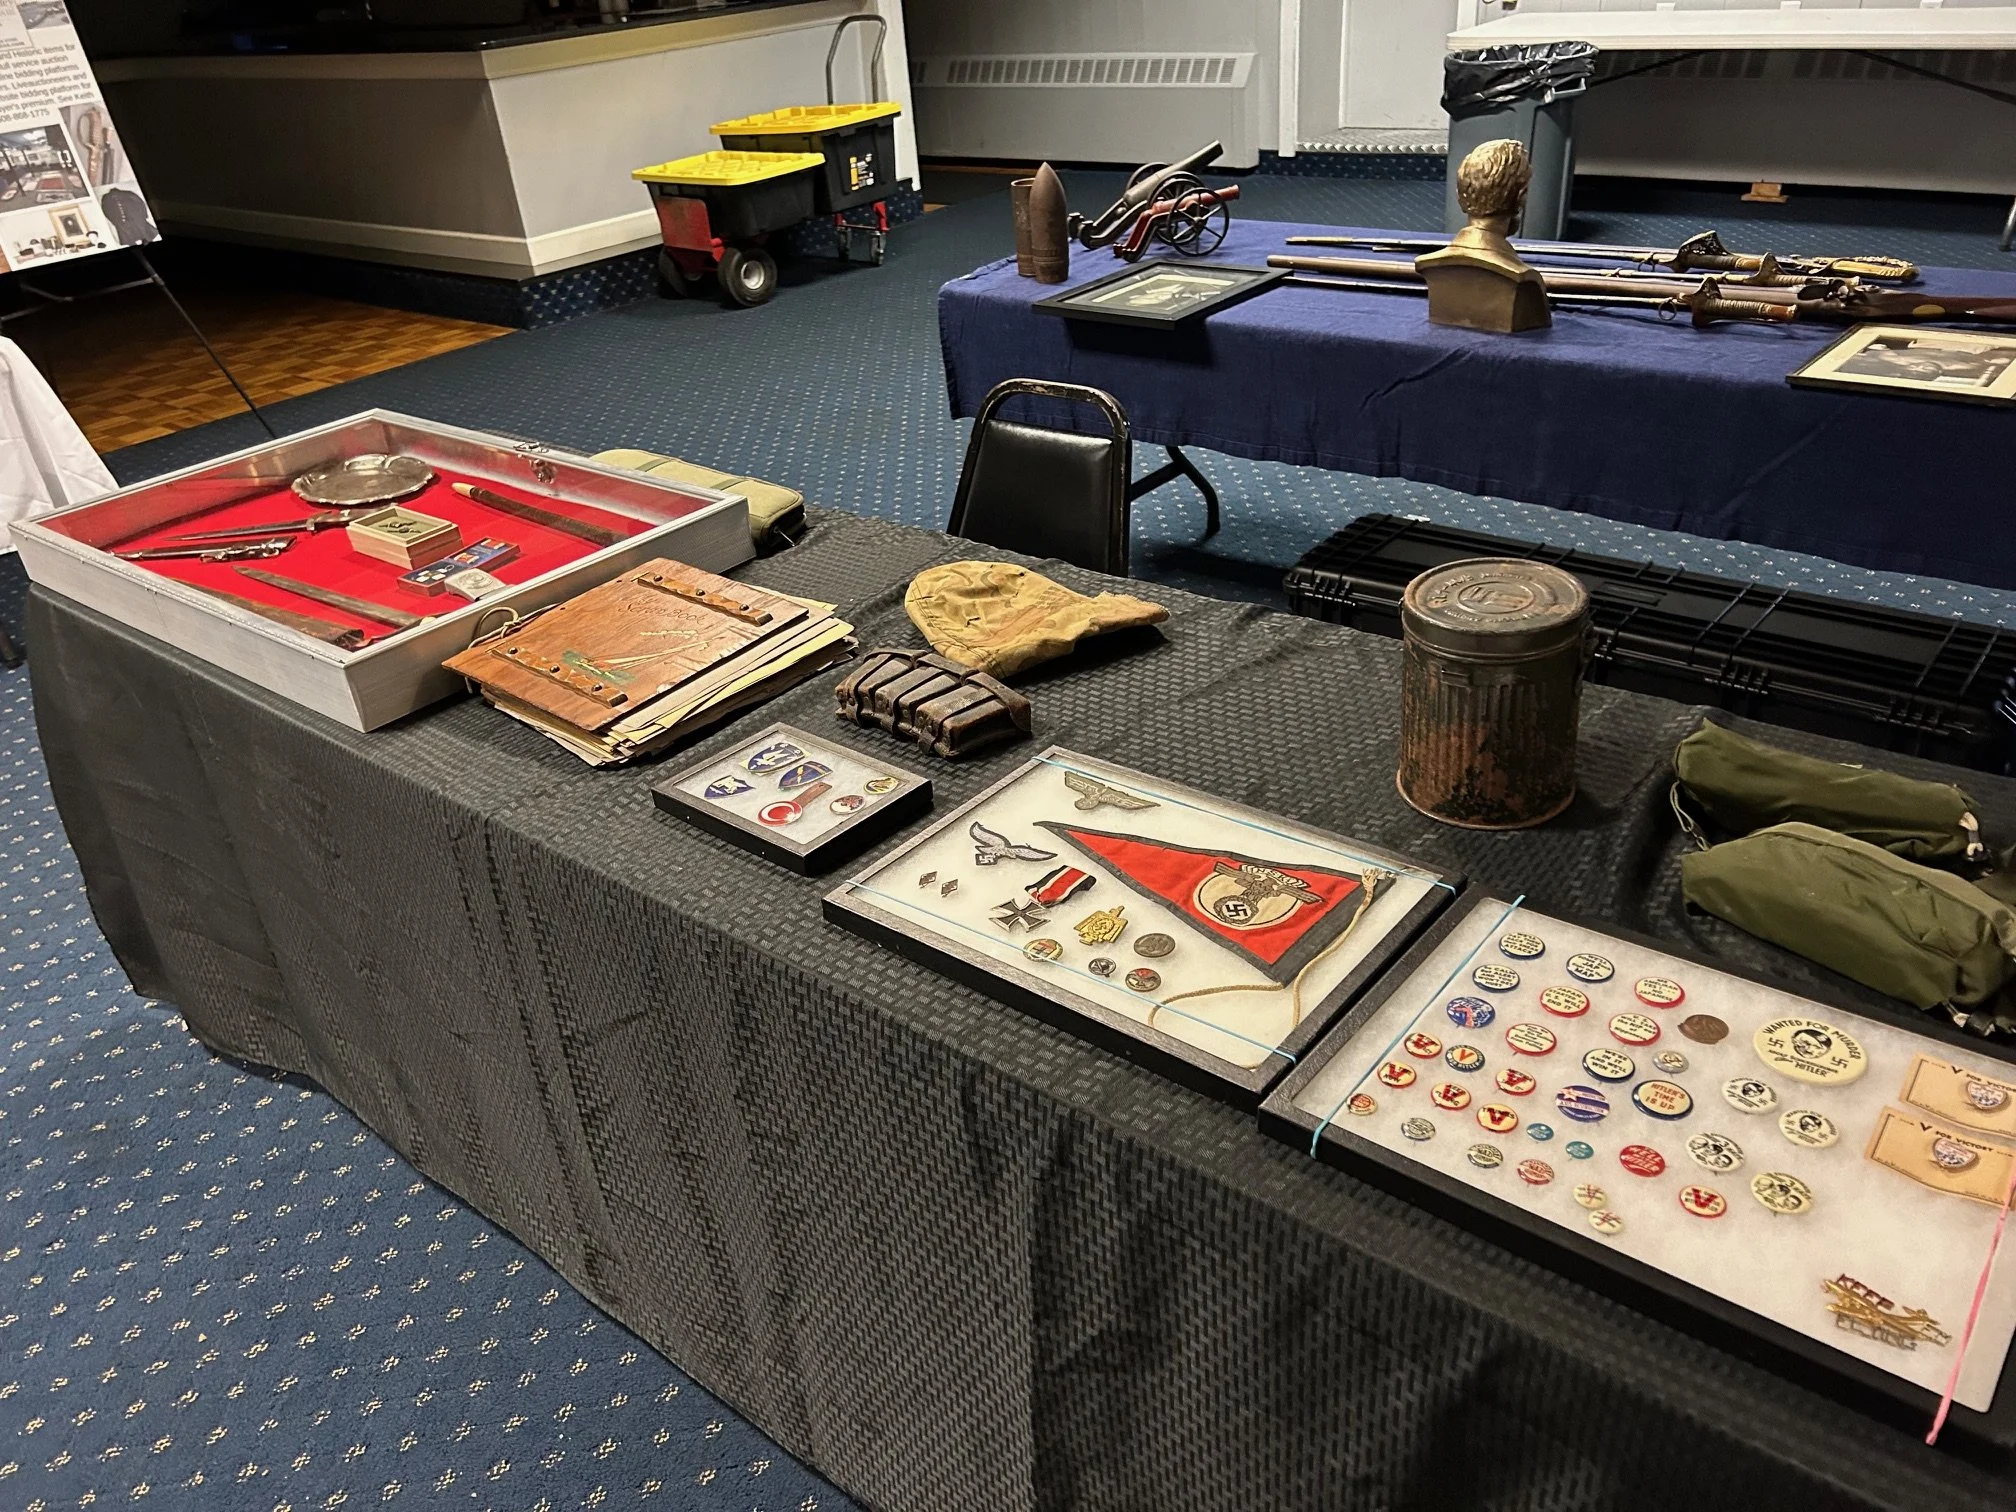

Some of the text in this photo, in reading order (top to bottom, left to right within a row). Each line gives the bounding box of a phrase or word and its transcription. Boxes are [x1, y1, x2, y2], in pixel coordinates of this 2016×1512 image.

[12, 60, 40, 69] service
[41, 55, 69, 65] auction
[14, 69, 43, 79] bidding
[73, 72, 87, 80] and
[20, 89, 50, 99] bidding
[50, 84, 81, 96] platform
[58, 95, 73, 103] See
[74, 91, 95, 100] Keith
[1505, 943, 1532, 953] ATTACK
[1582, 961, 1600, 969] JAP
[1574, 968, 1594, 977] MAP
[1548, 989, 1576, 999] STARTED
[1557, 987, 1582, 997] JAPAN
[1639, 989, 1673, 1001] JAPANESE
[1763, 1020, 1861, 1060] WANTED FOR MURDER
[1460, 1048, 1475, 1061] V
[1604, 1050, 1627, 1060] WE'RE
[1951, 1065, 1963, 1074] V
[1966, 1073, 1982, 1082] FOR
[1650, 1083, 1686, 1098] HITLER'S
[1645, 1096, 1674, 1110] IS UP
[1654, 1092, 1674, 1102] TIME
[1920, 1122, 1994, 1152] V FOR VICTORY
[1691, 1188, 1717, 1209] V
